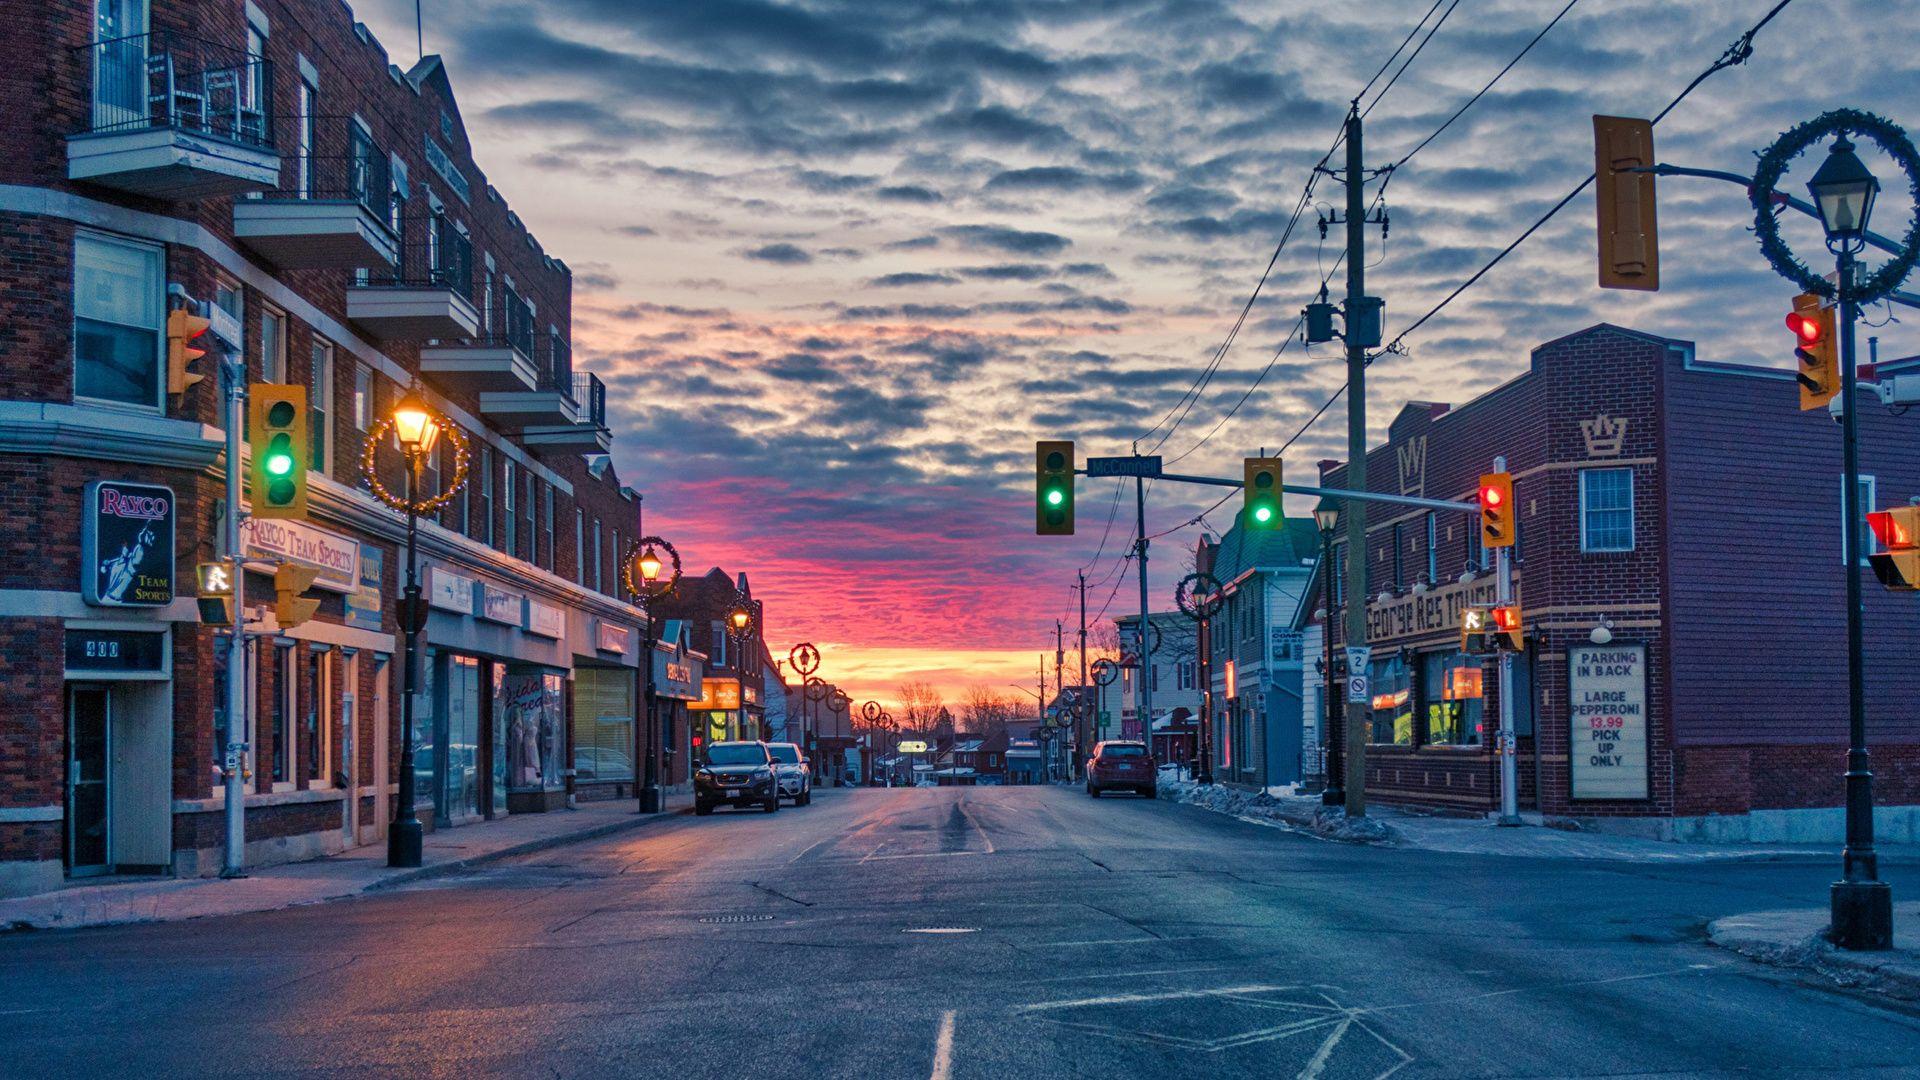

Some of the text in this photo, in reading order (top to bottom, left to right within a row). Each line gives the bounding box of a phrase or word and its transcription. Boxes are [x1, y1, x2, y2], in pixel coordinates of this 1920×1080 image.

[101, 488, 169, 519] RAYCO
[249, 519, 352, 571] RAYCO TEAM SPORTS
[138, 575, 168, 588] TEAM
[135, 588, 171, 600] SPORTS
[87, 642, 118, 657] 400
[1355, 656, 1362, 667] 2
[1581, 653, 1637, 663] PARKING
[1577, 665, 1632, 677] IN BACK
[1585, 691, 1626, 702] LARGE
[1572, 704, 1640, 715] PEPPERONI
[1590, 717, 1624, 728] 13.99
[1592, 730, 1621, 741] PICK
[1598, 743, 1615, 754] UP
[1590, 755, 1622, 767] ONLY
